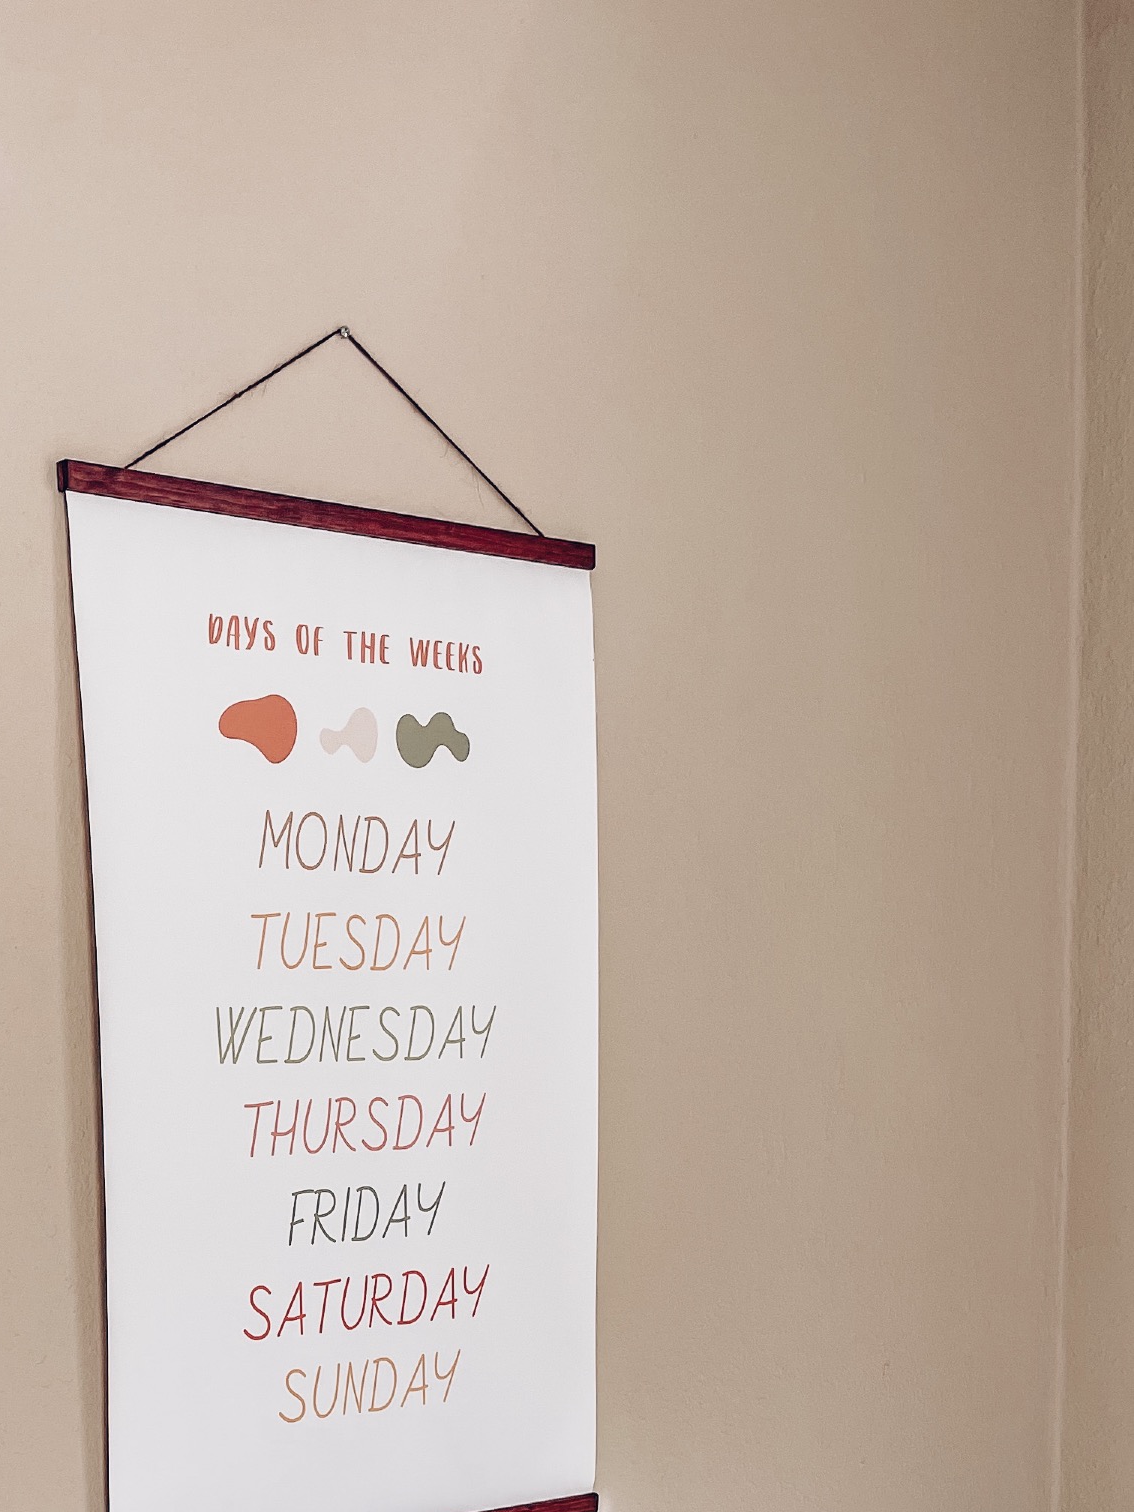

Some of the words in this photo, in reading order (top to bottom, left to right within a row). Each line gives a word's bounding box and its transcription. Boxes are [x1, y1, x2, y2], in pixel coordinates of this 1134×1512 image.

[208, 612, 276, 652] DAYS
[295, 623, 325, 657] OF
[343, 630, 391, 665] THE
[409, 636, 483, 675] WEEKS
[258, 809, 456, 876] MONDAY
[250, 911, 467, 972] TUESDAY
[215, 1004, 497, 1065] WEDNESDAY
[243, 1092, 487, 1158] THURSDAY
[288, 1180, 447, 1247] FRIDAY
[242, 1263, 490, 1341] SATURDAY
[278, 1348, 462, 1424] SUNDAY
